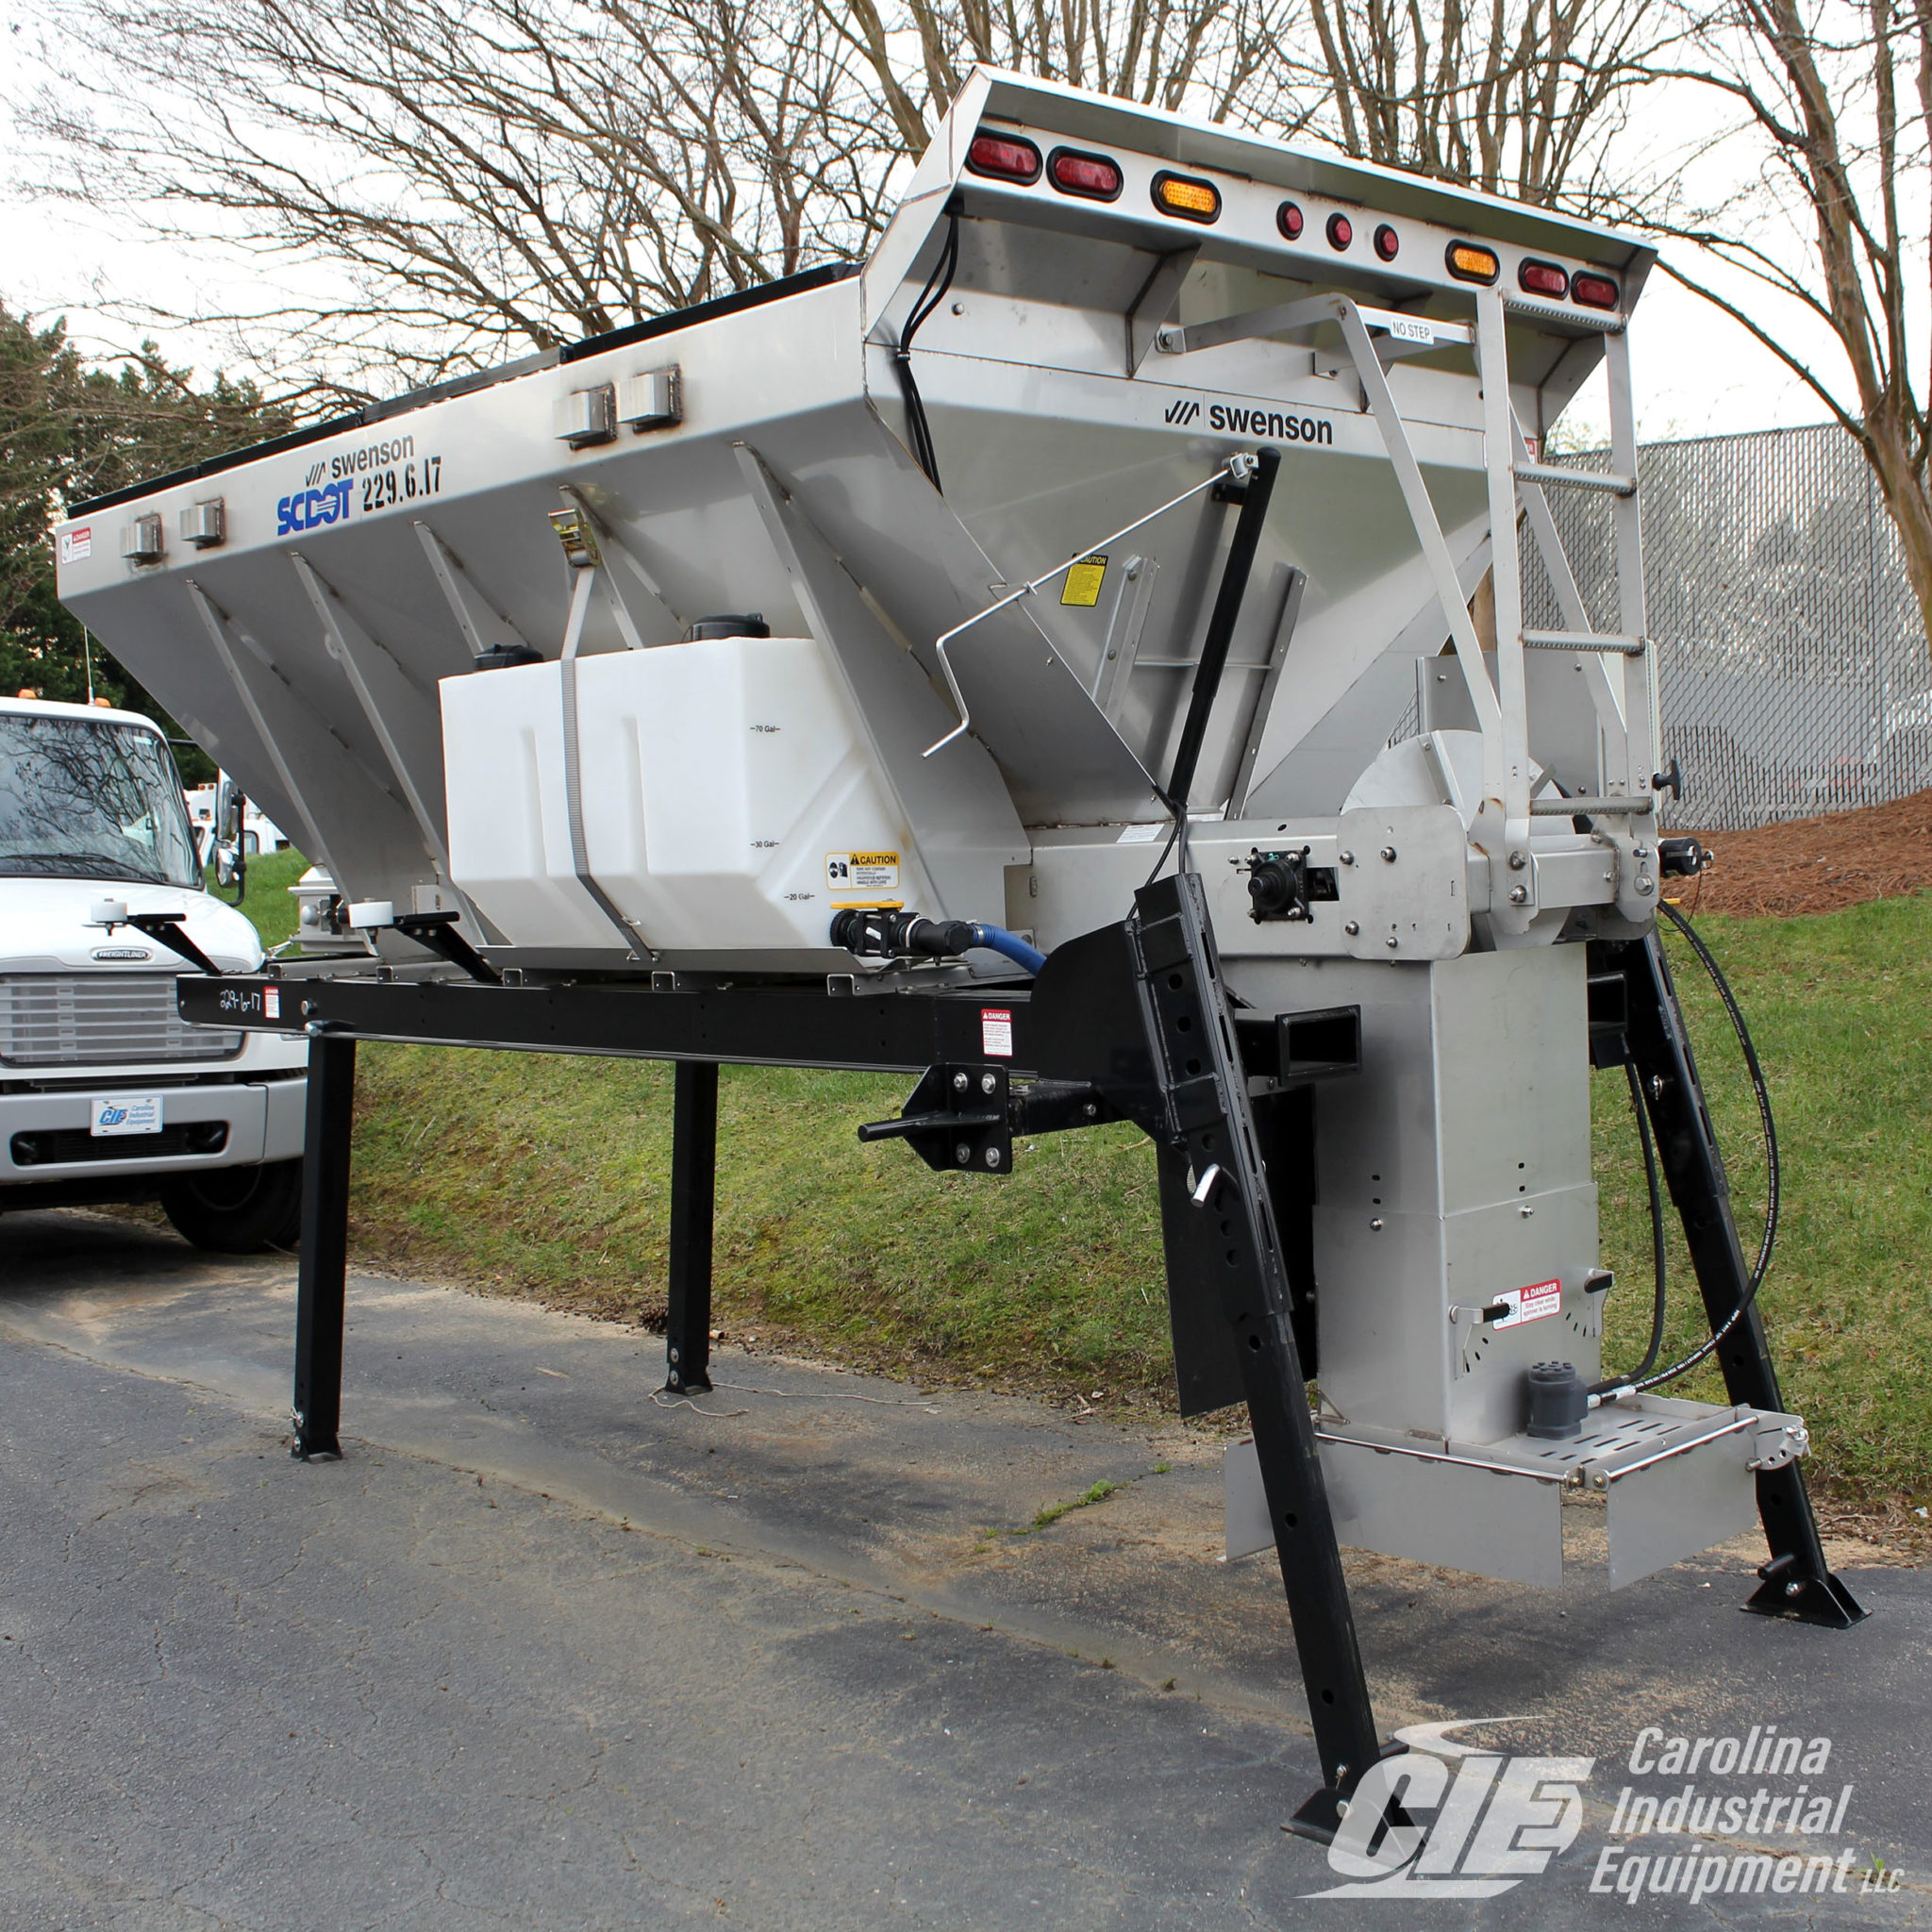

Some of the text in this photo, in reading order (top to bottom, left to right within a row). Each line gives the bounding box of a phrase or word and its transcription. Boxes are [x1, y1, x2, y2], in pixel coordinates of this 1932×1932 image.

[1392, 321, 1430, 340] NO STEP
[1209, 404, 1333, 445] swenson
[331, 434, 415, 479] swenson
[362, 455, 442, 512] 229.6.17
[277, 477, 355, 536] SCDOT
[1080, 556, 1107, 564] AUTION
[755, 724, 776, 733] 70 Gal
[764, 840, 775, 848] Gal
[859, 855, 897, 865] CAUTION
[798, 892, 810, 901] Gal
[988, 1012, 1010, 1021] DANGER
[99, 1108, 128, 1124] CIE
[1530, 1283, 1557, 1297] DANGER
